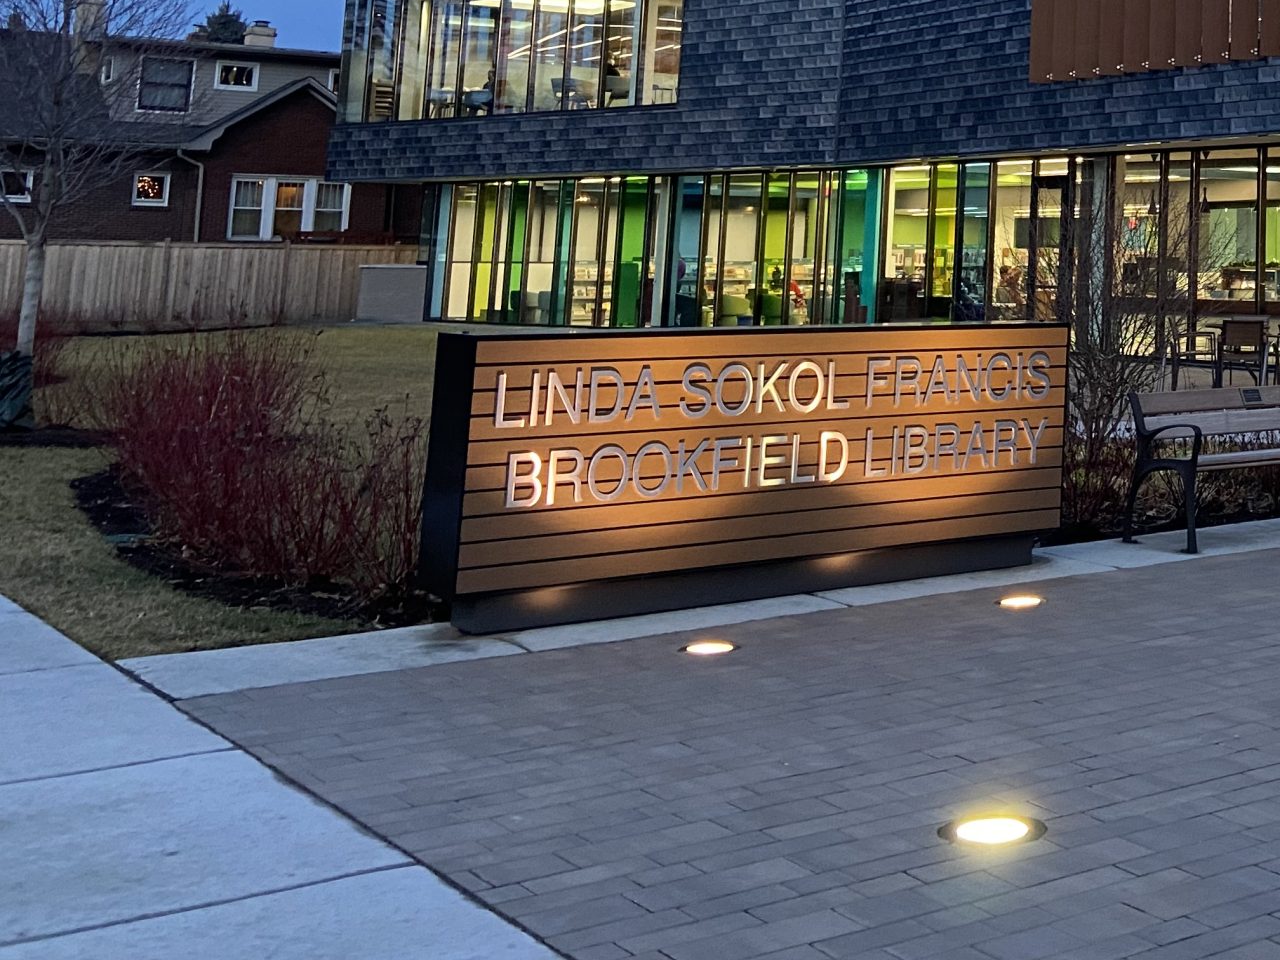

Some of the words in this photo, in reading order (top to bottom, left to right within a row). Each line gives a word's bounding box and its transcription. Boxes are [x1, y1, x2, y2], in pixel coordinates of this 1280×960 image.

[495, 365, 660, 428] LINDA
[679, 359, 850, 419] SOKOL
[865, 351, 1051, 409] FRANCIS
[505, 430, 849, 508] BROOKFIELD
[864, 417, 1048, 477] LIBRARY
